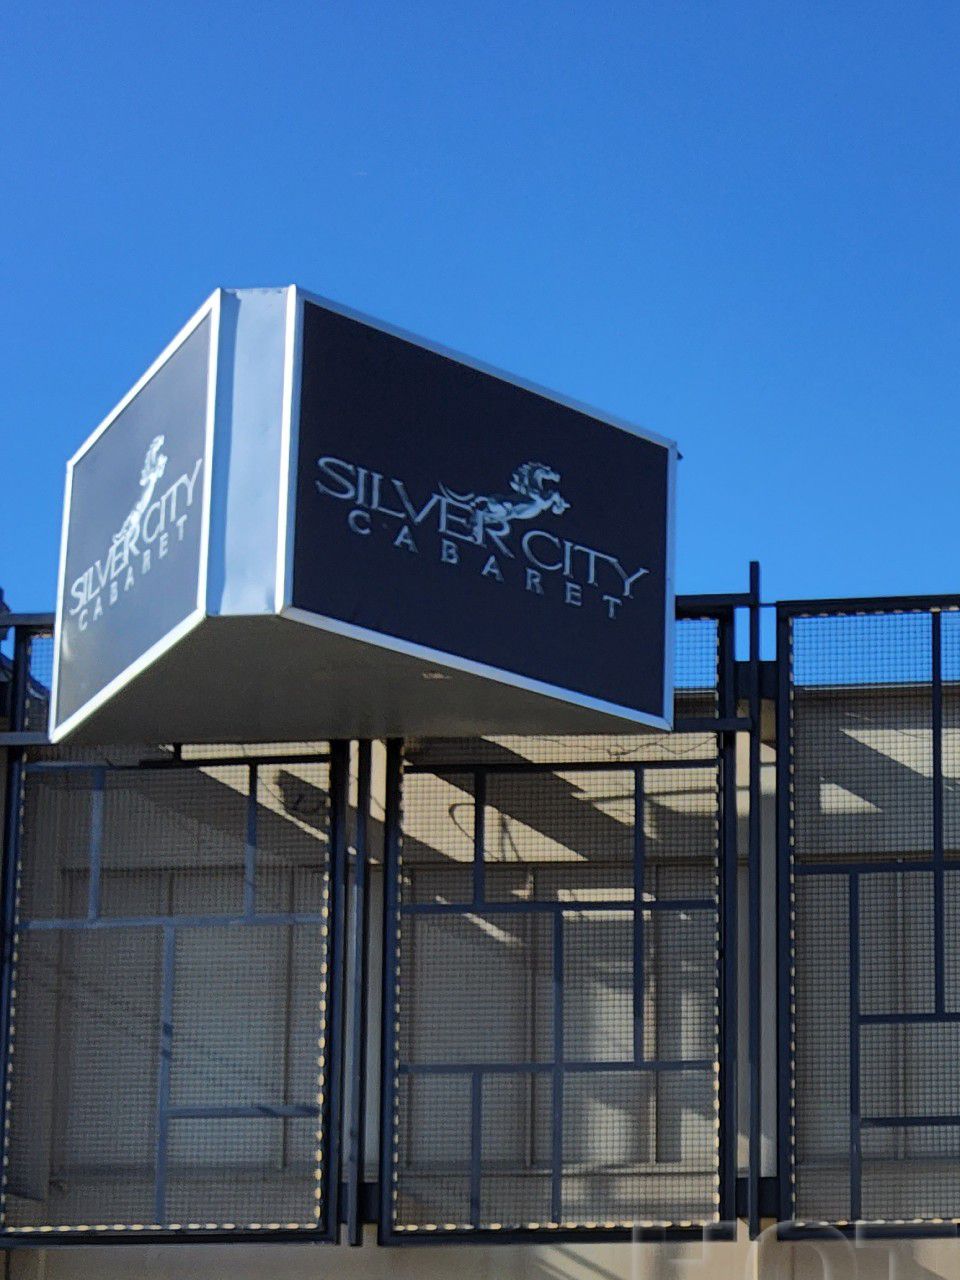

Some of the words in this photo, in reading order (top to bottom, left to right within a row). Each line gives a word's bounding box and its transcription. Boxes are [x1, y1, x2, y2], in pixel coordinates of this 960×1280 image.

[69, 524, 140, 616] SILVER
[142, 457, 203, 544] CITY
[78, 514, 188, 631] CABARET
[315, 456, 515, 559] SILVER
[521, 529, 650, 599] CITY
[348, 509, 623, 619] CABARET
